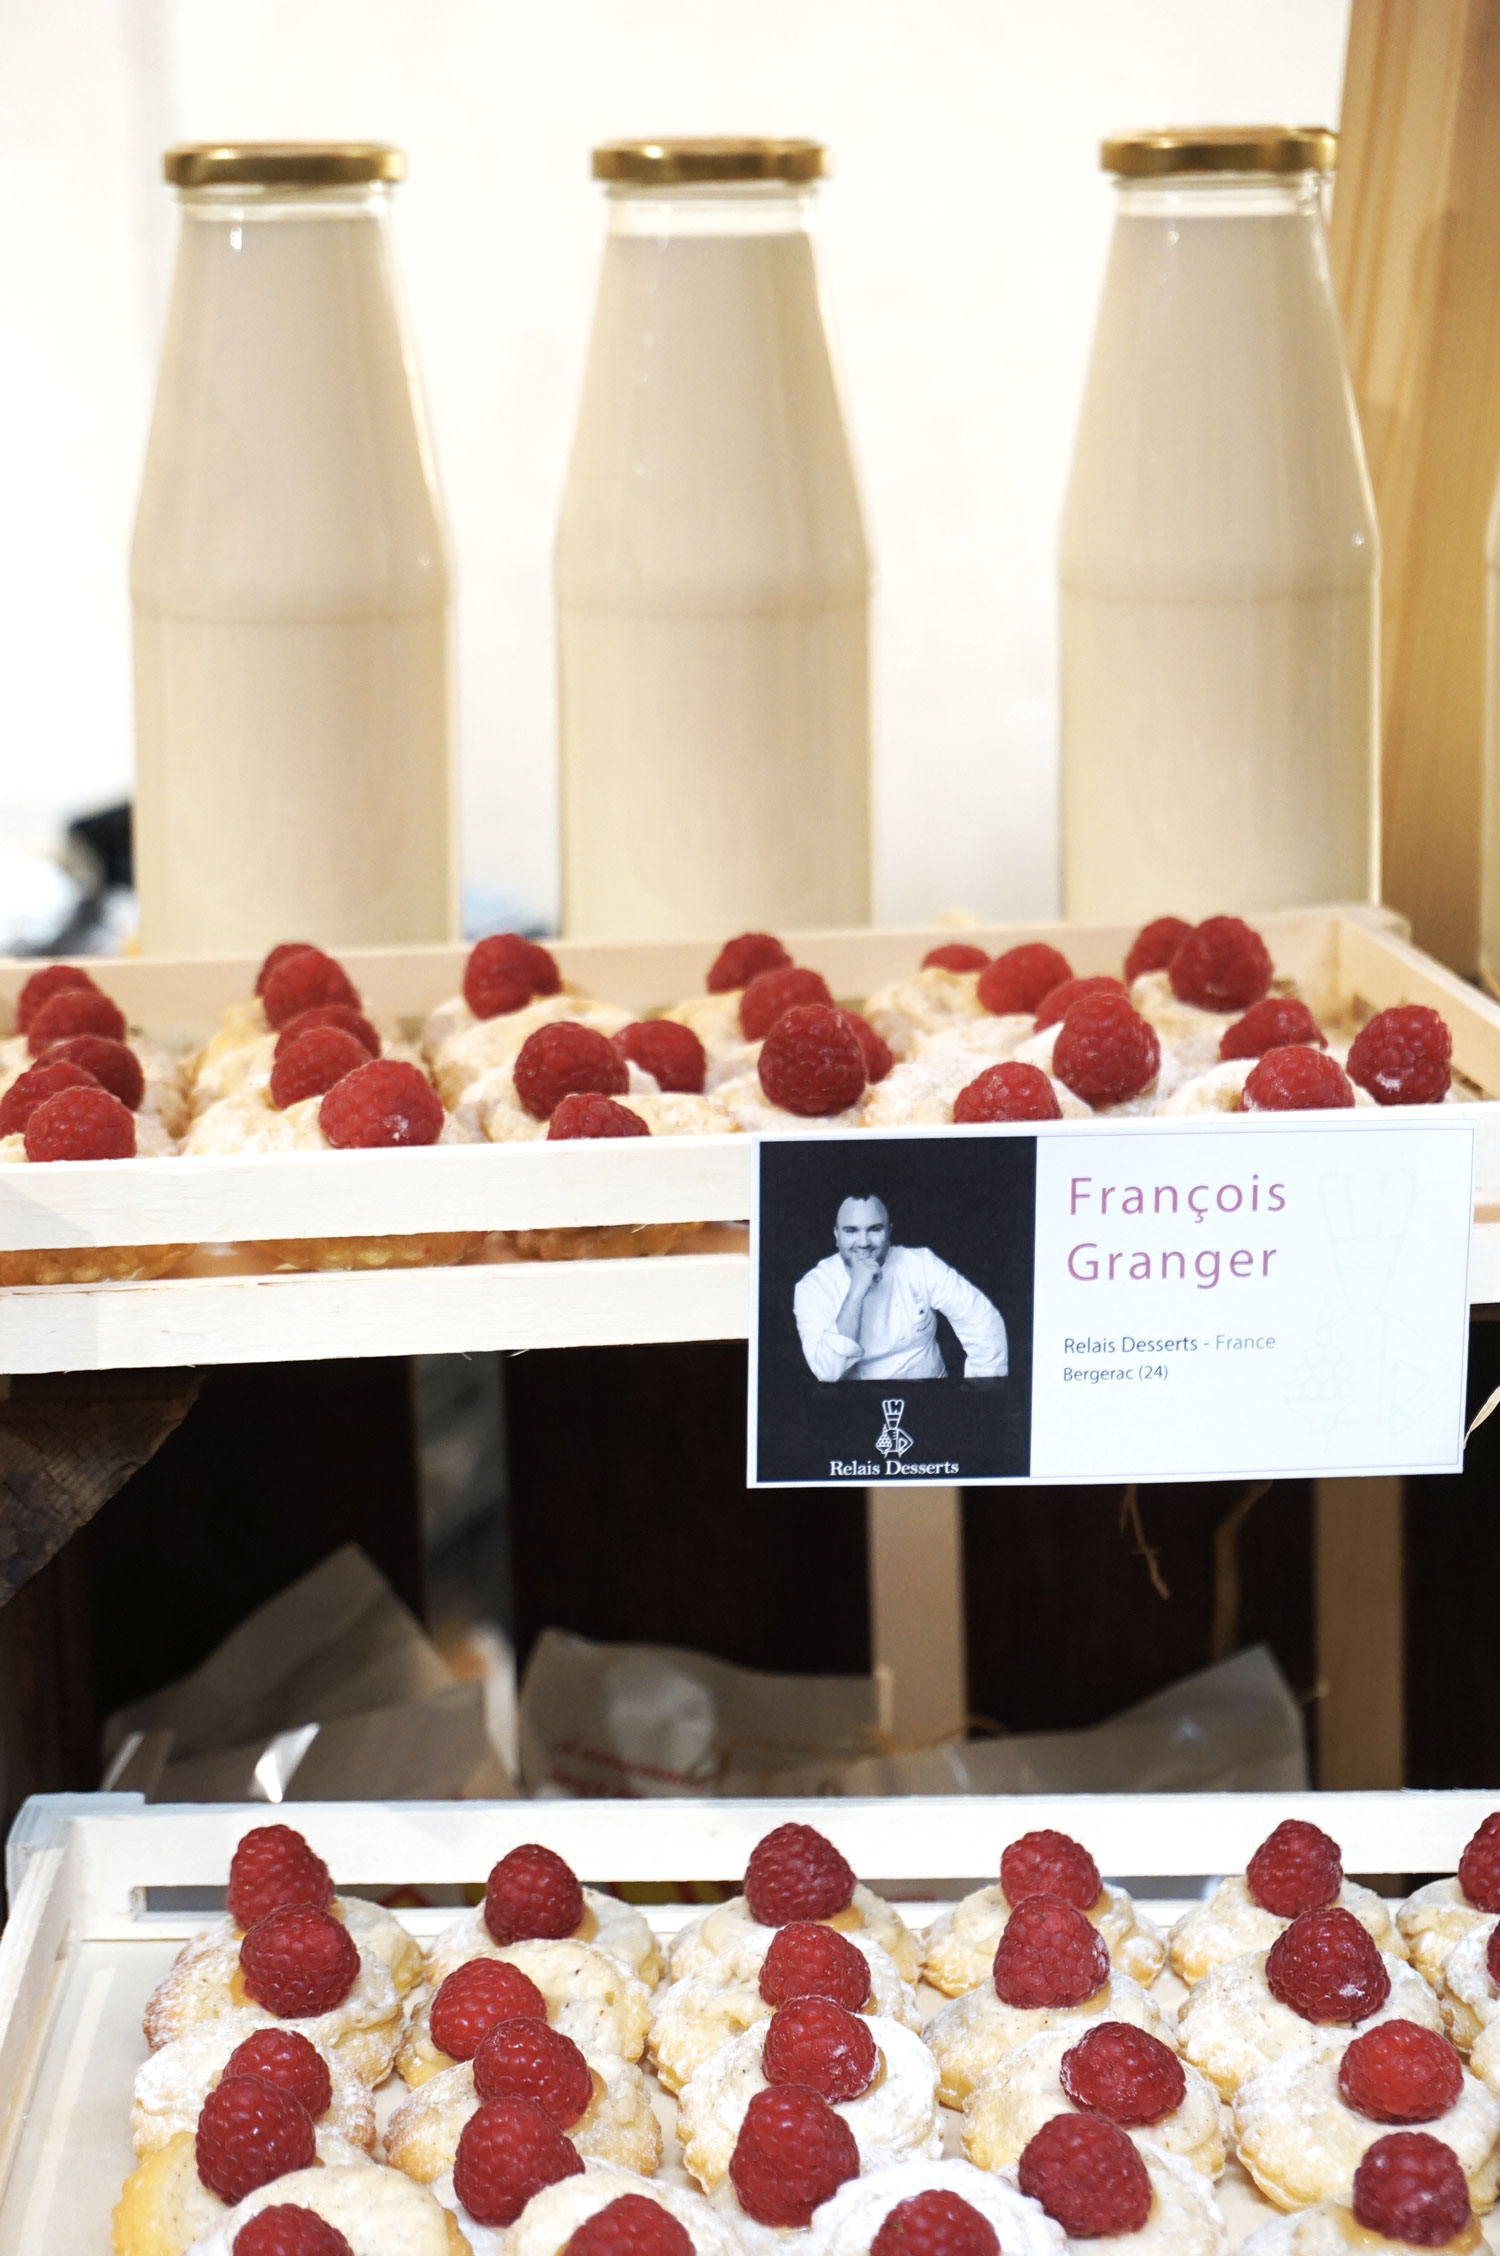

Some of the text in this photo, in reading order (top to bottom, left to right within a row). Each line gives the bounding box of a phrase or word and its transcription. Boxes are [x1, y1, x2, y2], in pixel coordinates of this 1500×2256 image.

[1070, 1173, 1287, 1224] François
[1067, 1242, 1278, 1290] Granger
[1064, 1336, 1116, 1354] Relais
[1121, 1335, 1198, 1353] Desserts
[1215, 1334, 1276, 1350] France
[1063, 1364, 1169, 1385] Bergerac (24)
[829, 1460, 960, 1476] Relais Desserts
